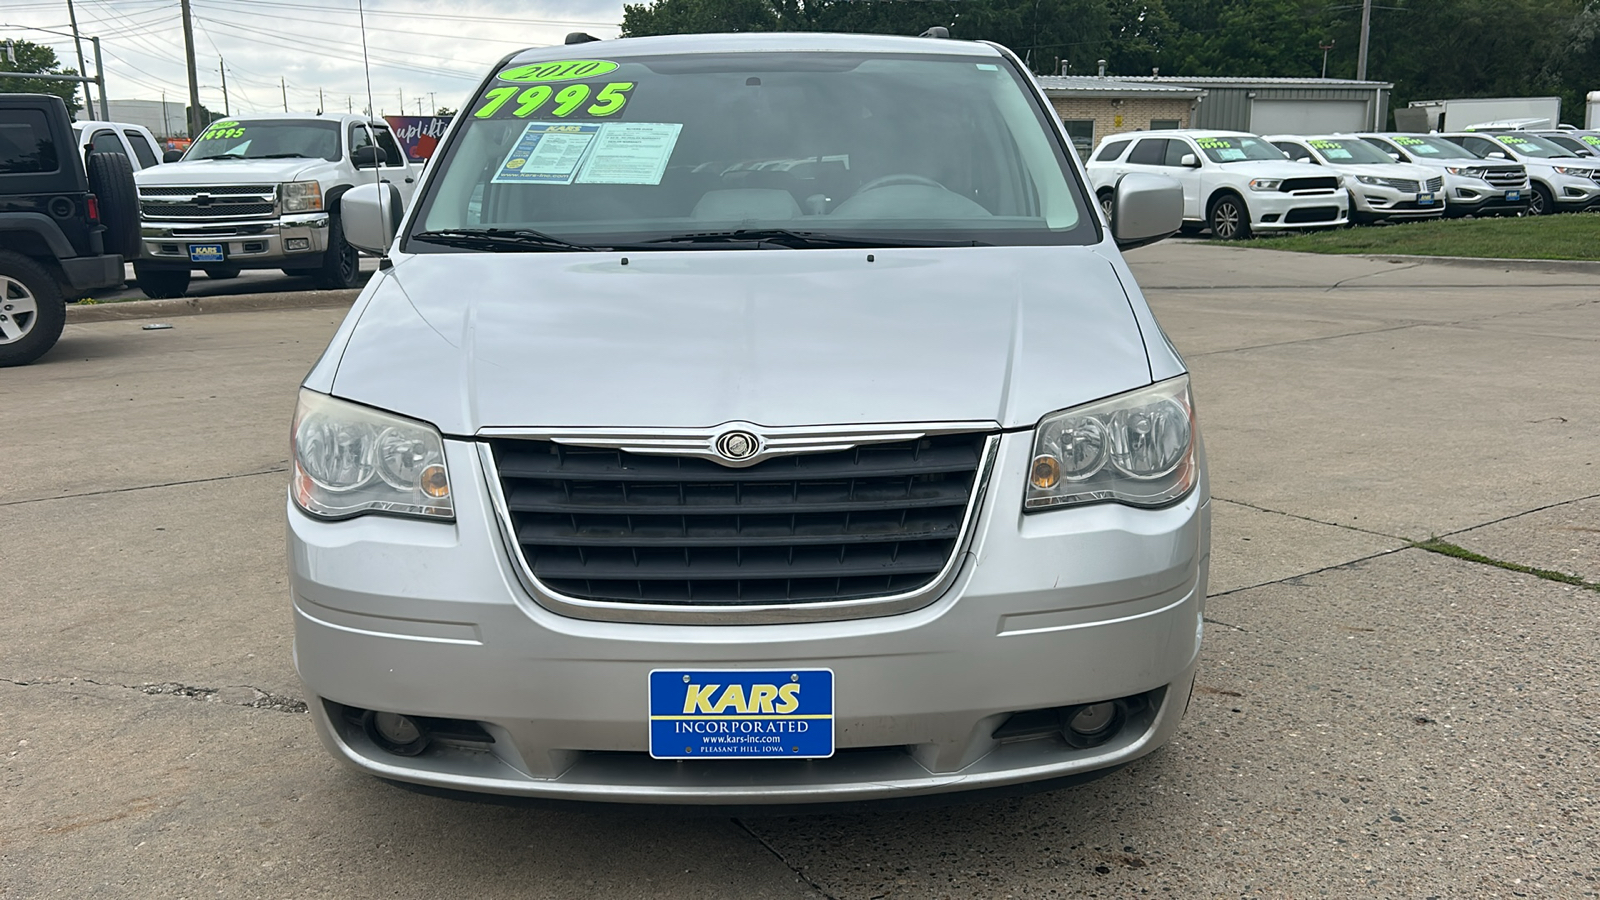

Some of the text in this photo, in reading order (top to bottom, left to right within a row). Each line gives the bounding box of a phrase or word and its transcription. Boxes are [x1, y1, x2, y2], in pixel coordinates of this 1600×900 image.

[513, 62, 600, 80] 2010
[473, 82, 634, 118] 7995
[195, 246, 217, 254] KARS
[683, 683, 800, 714] KARS
[675, 721, 809, 733] INCORPORATED
[702, 734, 781, 744] www.kars-inc.com
